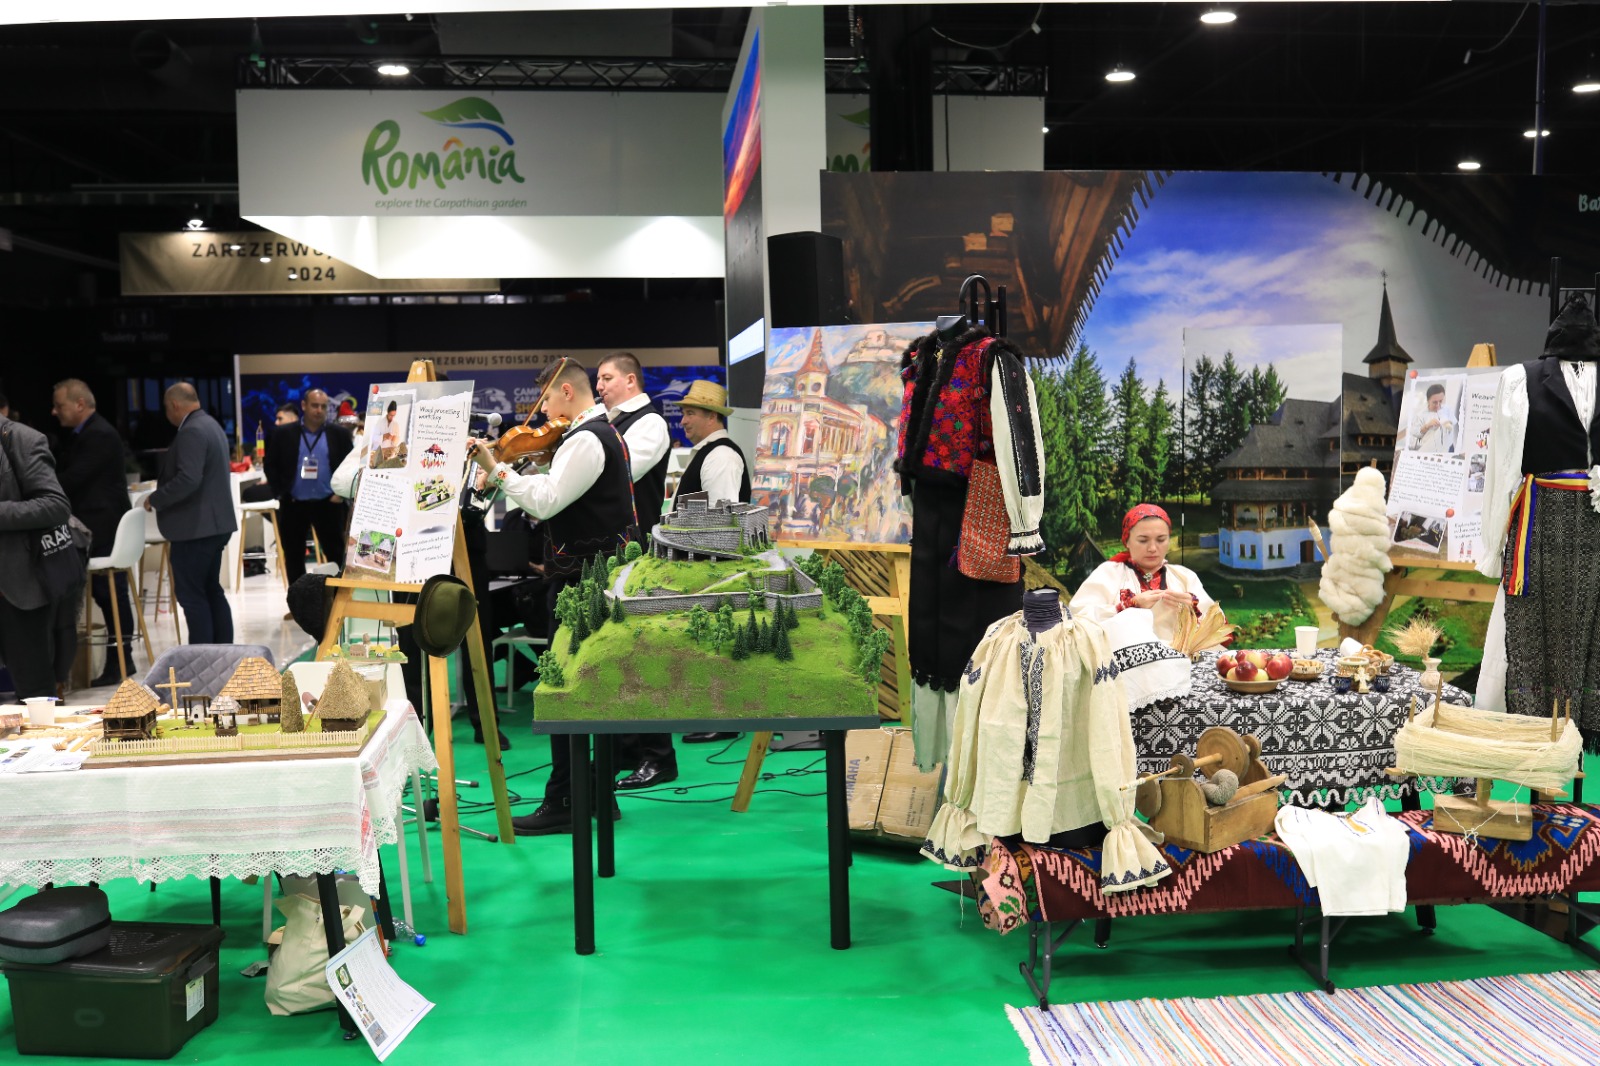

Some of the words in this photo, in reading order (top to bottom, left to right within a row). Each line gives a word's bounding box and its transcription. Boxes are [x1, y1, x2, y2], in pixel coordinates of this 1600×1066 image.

[362, 120, 525, 195] România
[375, 198, 413, 209] explore
[415, 198, 430, 208] the
[433, 198, 490, 210] Carpathian
[491, 198, 527, 210] garden
[1579, 194, 1600, 212] Ba
[192, 242, 332, 259] ZAREZERW
[287, 266, 336, 281] 2024
[413, 355, 488, 367] EZERWUJ
[491, 354, 540, 365] STOISKO
[513, 387, 541, 396] CAMP
[515, 402, 541, 414] SH
[845, 758, 861, 801] AMAHA
